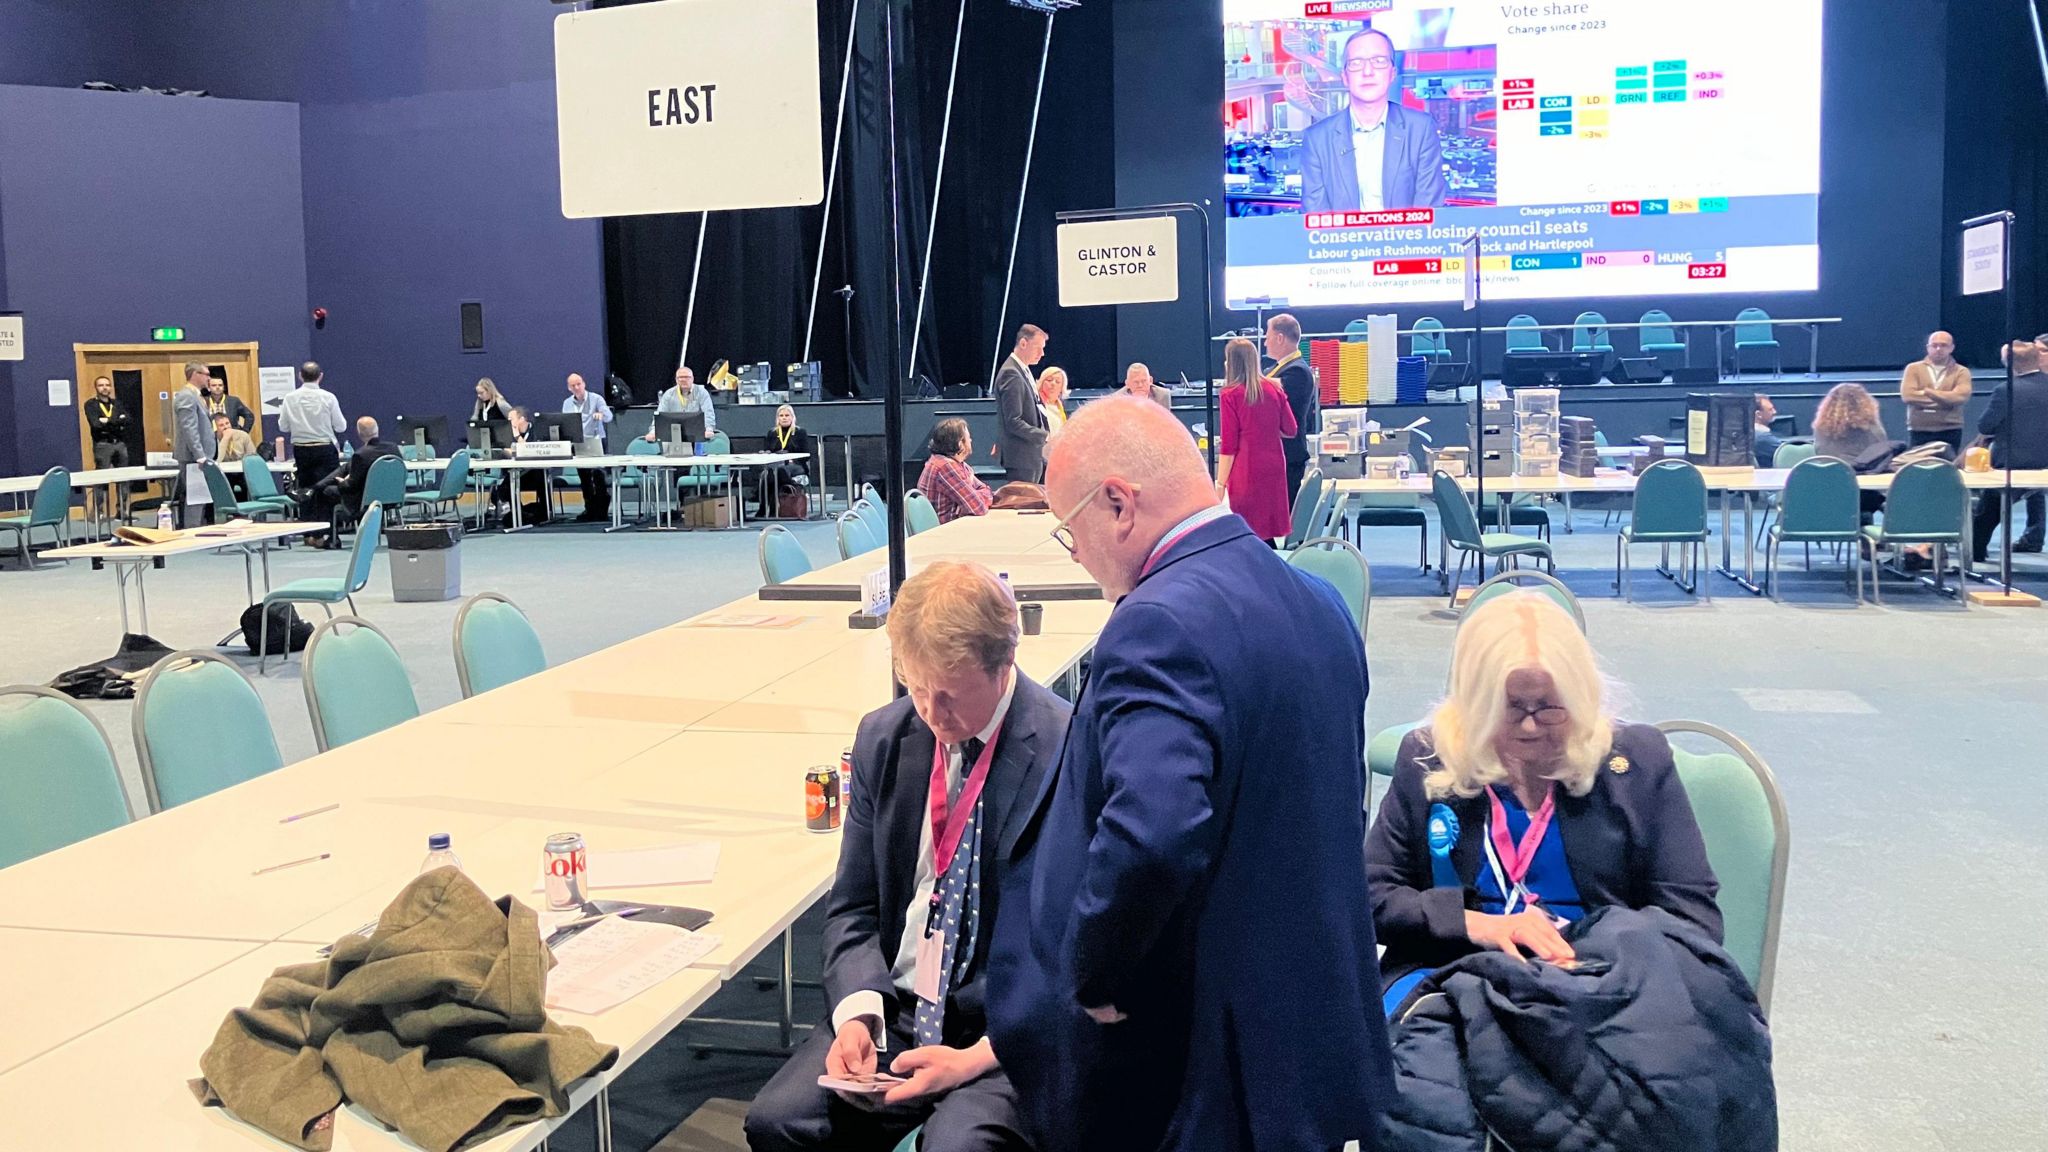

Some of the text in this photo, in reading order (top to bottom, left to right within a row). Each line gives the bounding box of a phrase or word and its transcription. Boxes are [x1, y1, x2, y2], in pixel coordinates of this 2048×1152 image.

[1307, 4, 1328, 14] LIVE
[1333, 0, 1390, 12] NEWSROOM
[1501, 2, 1589, 18] Vote share
[1507, 20, 1607, 35] Change since 2023
[1620, 93, 1643, 103] GRN
[1660, 92, 1680, 101] REF
[1699, 89, 1718, 98] IND
[648, 84, 716, 127] EAST
[1508, 99, 1530, 110] LAB
[1544, 97, 1568, 107] CON
[1586, 96, 1600, 105] LD
[1520, 203, 1608, 217] Change since 2023
[1615, 203, 1637, 212] +1%
[1645, 202, 1664, 211] -2%
[1346, 213, 1404, 224] ELECTIONS
[1405, 211, 1431, 222] 2024
[1308, 220, 1588, 244] Conservatives losing council seats
[1078, 244, 1156, 261] GLINTON &
[1308, 248, 1349, 259] Labour
[1351, 246, 1381, 260] gains
[1383, 244, 1447, 256] Rushmoor,
[1504, 240, 1528, 250] and
[1529, 238, 1594, 252] Hartlepool
[1515, 257, 1577, 268] CON 1
[1586, 254, 1650, 265] IND 0
[1658, 252, 1693, 263] HUNG
[1088, 262, 1147, 277] CASTOR
[1310, 266, 1351, 275] Councils
[1376, 262, 1438, 273] LAB 12
[1446, 260, 1506, 270] LD 1
[1691, 266, 1723, 277] 03:27
[1316, 280, 1346, 289] Follow
[1349, 279, 1365, 288] full
[1368, 278, 1409, 288] coverage
